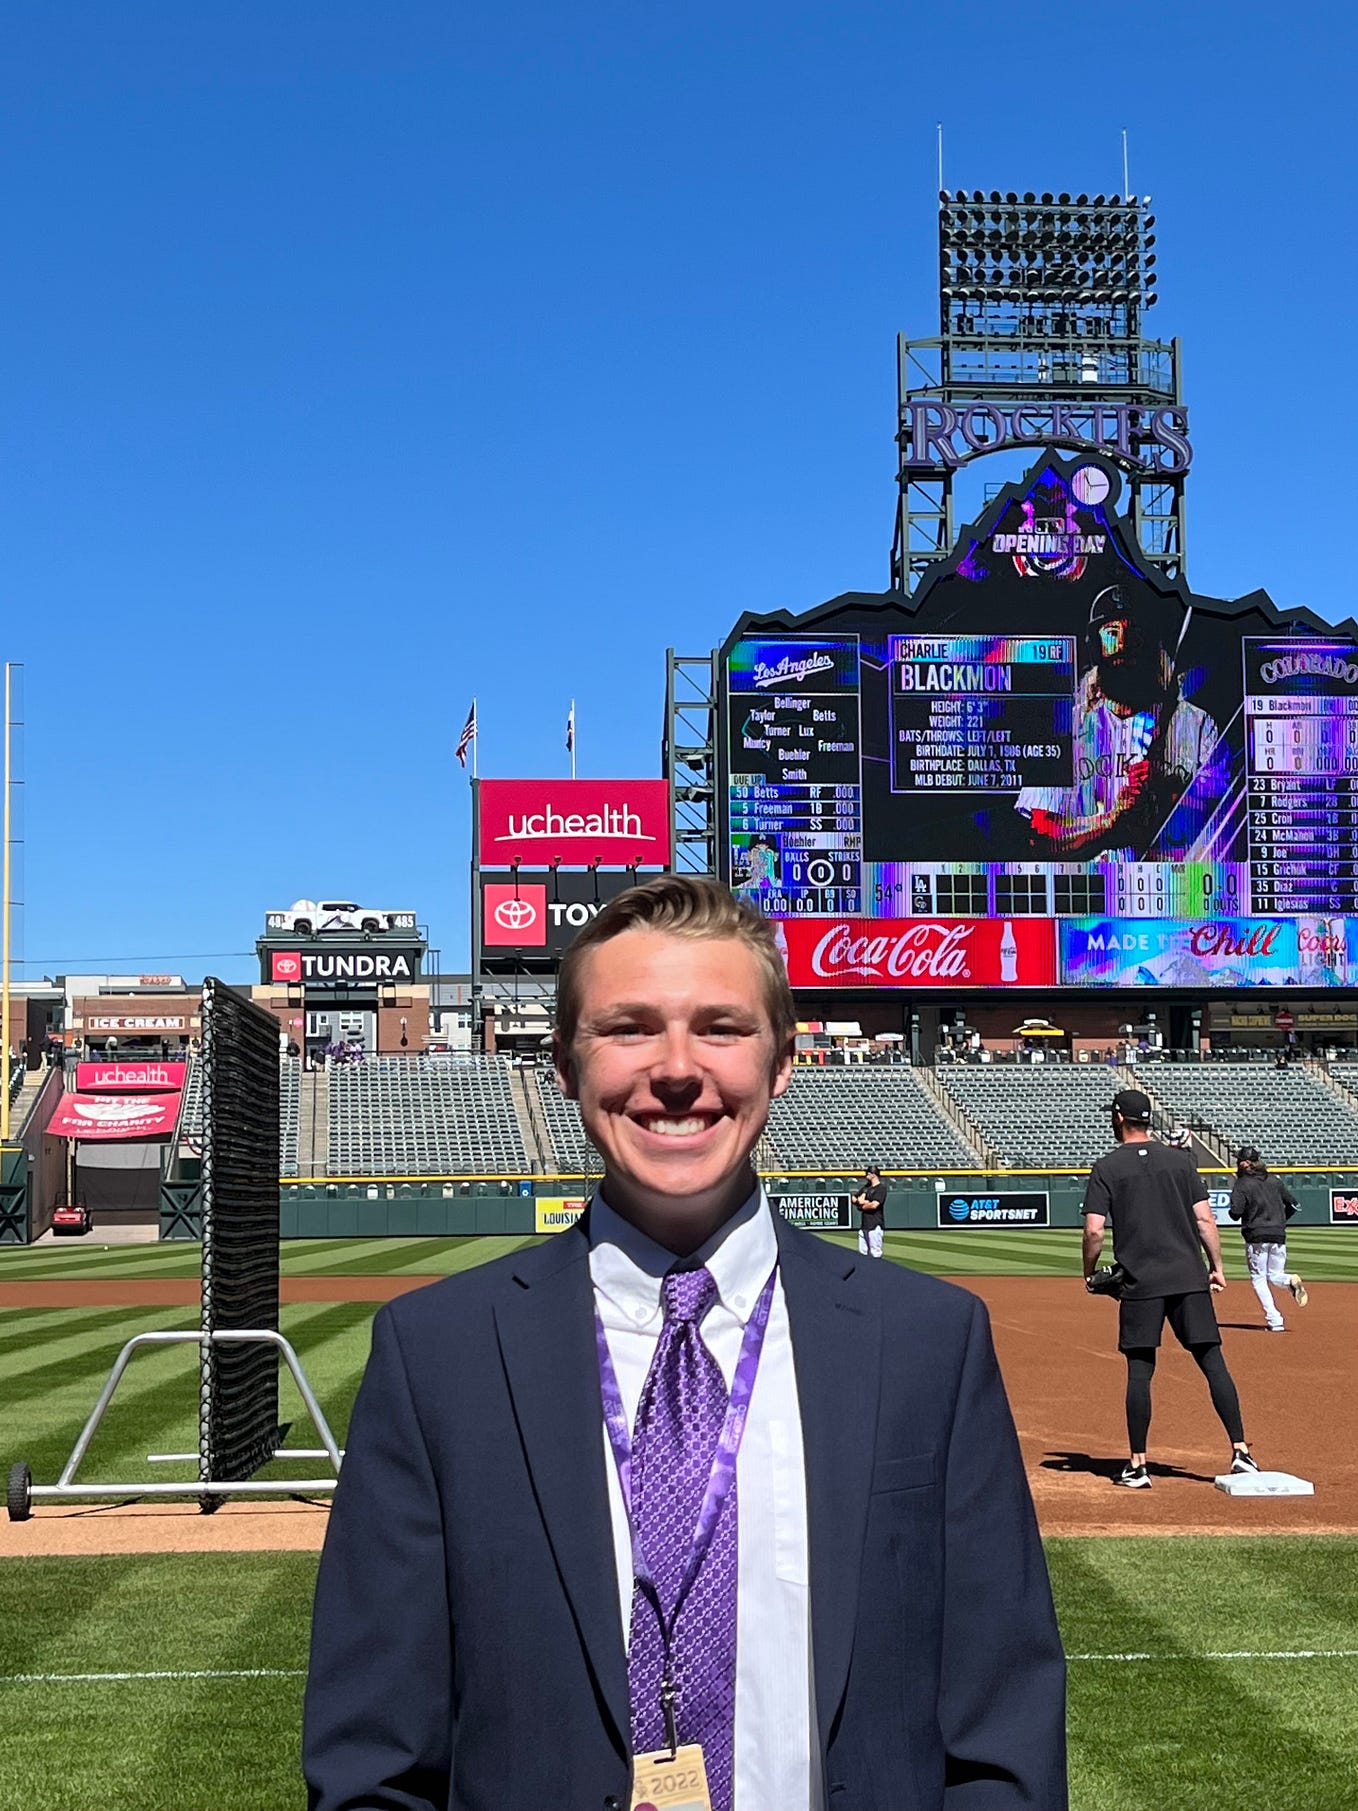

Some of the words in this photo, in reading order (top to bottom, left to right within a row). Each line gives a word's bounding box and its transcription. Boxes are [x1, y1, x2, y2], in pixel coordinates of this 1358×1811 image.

[904, 401, 1193, 472] ROCKIES
[993, 534, 1070, 553] OPENING
[1073, 535, 1106, 553] DAY
[901, 643, 949, 659] CHARLIE
[1033, 645, 1046, 660] 19
[753, 662, 777, 680] Los
[775, 651, 831, 681] Angeles
[901, 664, 1012, 691] BLACKMON
[774, 697, 811, 711] Bellinger
[1252, 700, 1263, 711] 19
[1269, 700, 1311, 711] Blackmon
[750, 709, 775, 723] Taylor
[813, 710, 836, 721] Betts
[764, 725, 791, 736] Turner
[798, 725, 814, 736] Lux
[967, 730, 1011, 742] LEFT/LEFT
[743, 737, 771, 751] Muncy
[818, 740, 854, 751] Freeman
[778, 749, 810, 760] Buehler
[966, 745, 987, 757] JULY
[1022, 745, 1043, 759] (AGE
[1046, 745, 1061, 759] 35)
[1005, 760, 1016, 772] TX
[782, 768, 807, 780] Smith
[915, 774, 933, 786] MLB
[967, 774, 989, 786] JUNE
[1000, 774, 1022, 786] 2011
[1253, 779, 1265, 790] 23
[1271, 779, 1301, 792] Bryant
[736, 787, 748, 798] 50
[754, 787, 779, 798] Betts
[810, 787, 822, 798] RF
[743, 803, 748, 814] 5
[754, 803, 792, 814] Freeman
[810, 803, 822, 814] 1B
[1260, 796, 1266, 807] 7
[1271, 796, 1307, 809] Rodgers
[508, 803, 642, 836] uchealth
[1254, 813, 1266, 824] 25
[1272, 813, 1292, 824] Cron
[743, 820, 748, 830] 6
[755, 820, 784, 830] Turner
[810, 820, 822, 830] SS
[1255, 830, 1266, 841] 24
[1272, 830, 1314, 841] McMahon
[785, 852, 809, 862] BALLS
[828, 852, 860, 862] STRIKES
[1261, 847, 1267, 858] 9
[1273, 847, 1287, 858] Joe
[793, 864, 801, 881] 0
[843, 864, 851, 881] 0
[1256, 864, 1268, 875] 15
[1273, 864, 1307, 875] Grichuk
[1256, 881, 1268, 892] 35
[1274, 881, 1293, 892] Diaz
[1214, 899, 1238, 911] OUTS
[1258, 898, 1268, 909] 11
[1274, 898, 1308, 911] Iglesias
[1088, 934, 1149, 950] MADE
[1190, 923, 1282, 957] Chill
[1298, 928, 1346, 951] Coors
[812, 923, 975, 978] Coca-Cola
[1302, 953, 1344, 966] LIGHT
[302, 955, 411, 977] TUNDRA
[94, 1018, 119, 1028] ICE
[124, 1018, 179, 1028] CREAM
[95, 1066, 168, 1084] uchealth
[97, 1116, 165, 1127] CHARITY
[780, 1196, 838, 1208] AMERICAN
[970, 1199, 999, 1209] AT&T
[779, 1208, 838, 1219] FINANCING
[970, 1209, 1038, 1220] SPORTSNET
[651, 1770, 700, 1795] 2022
